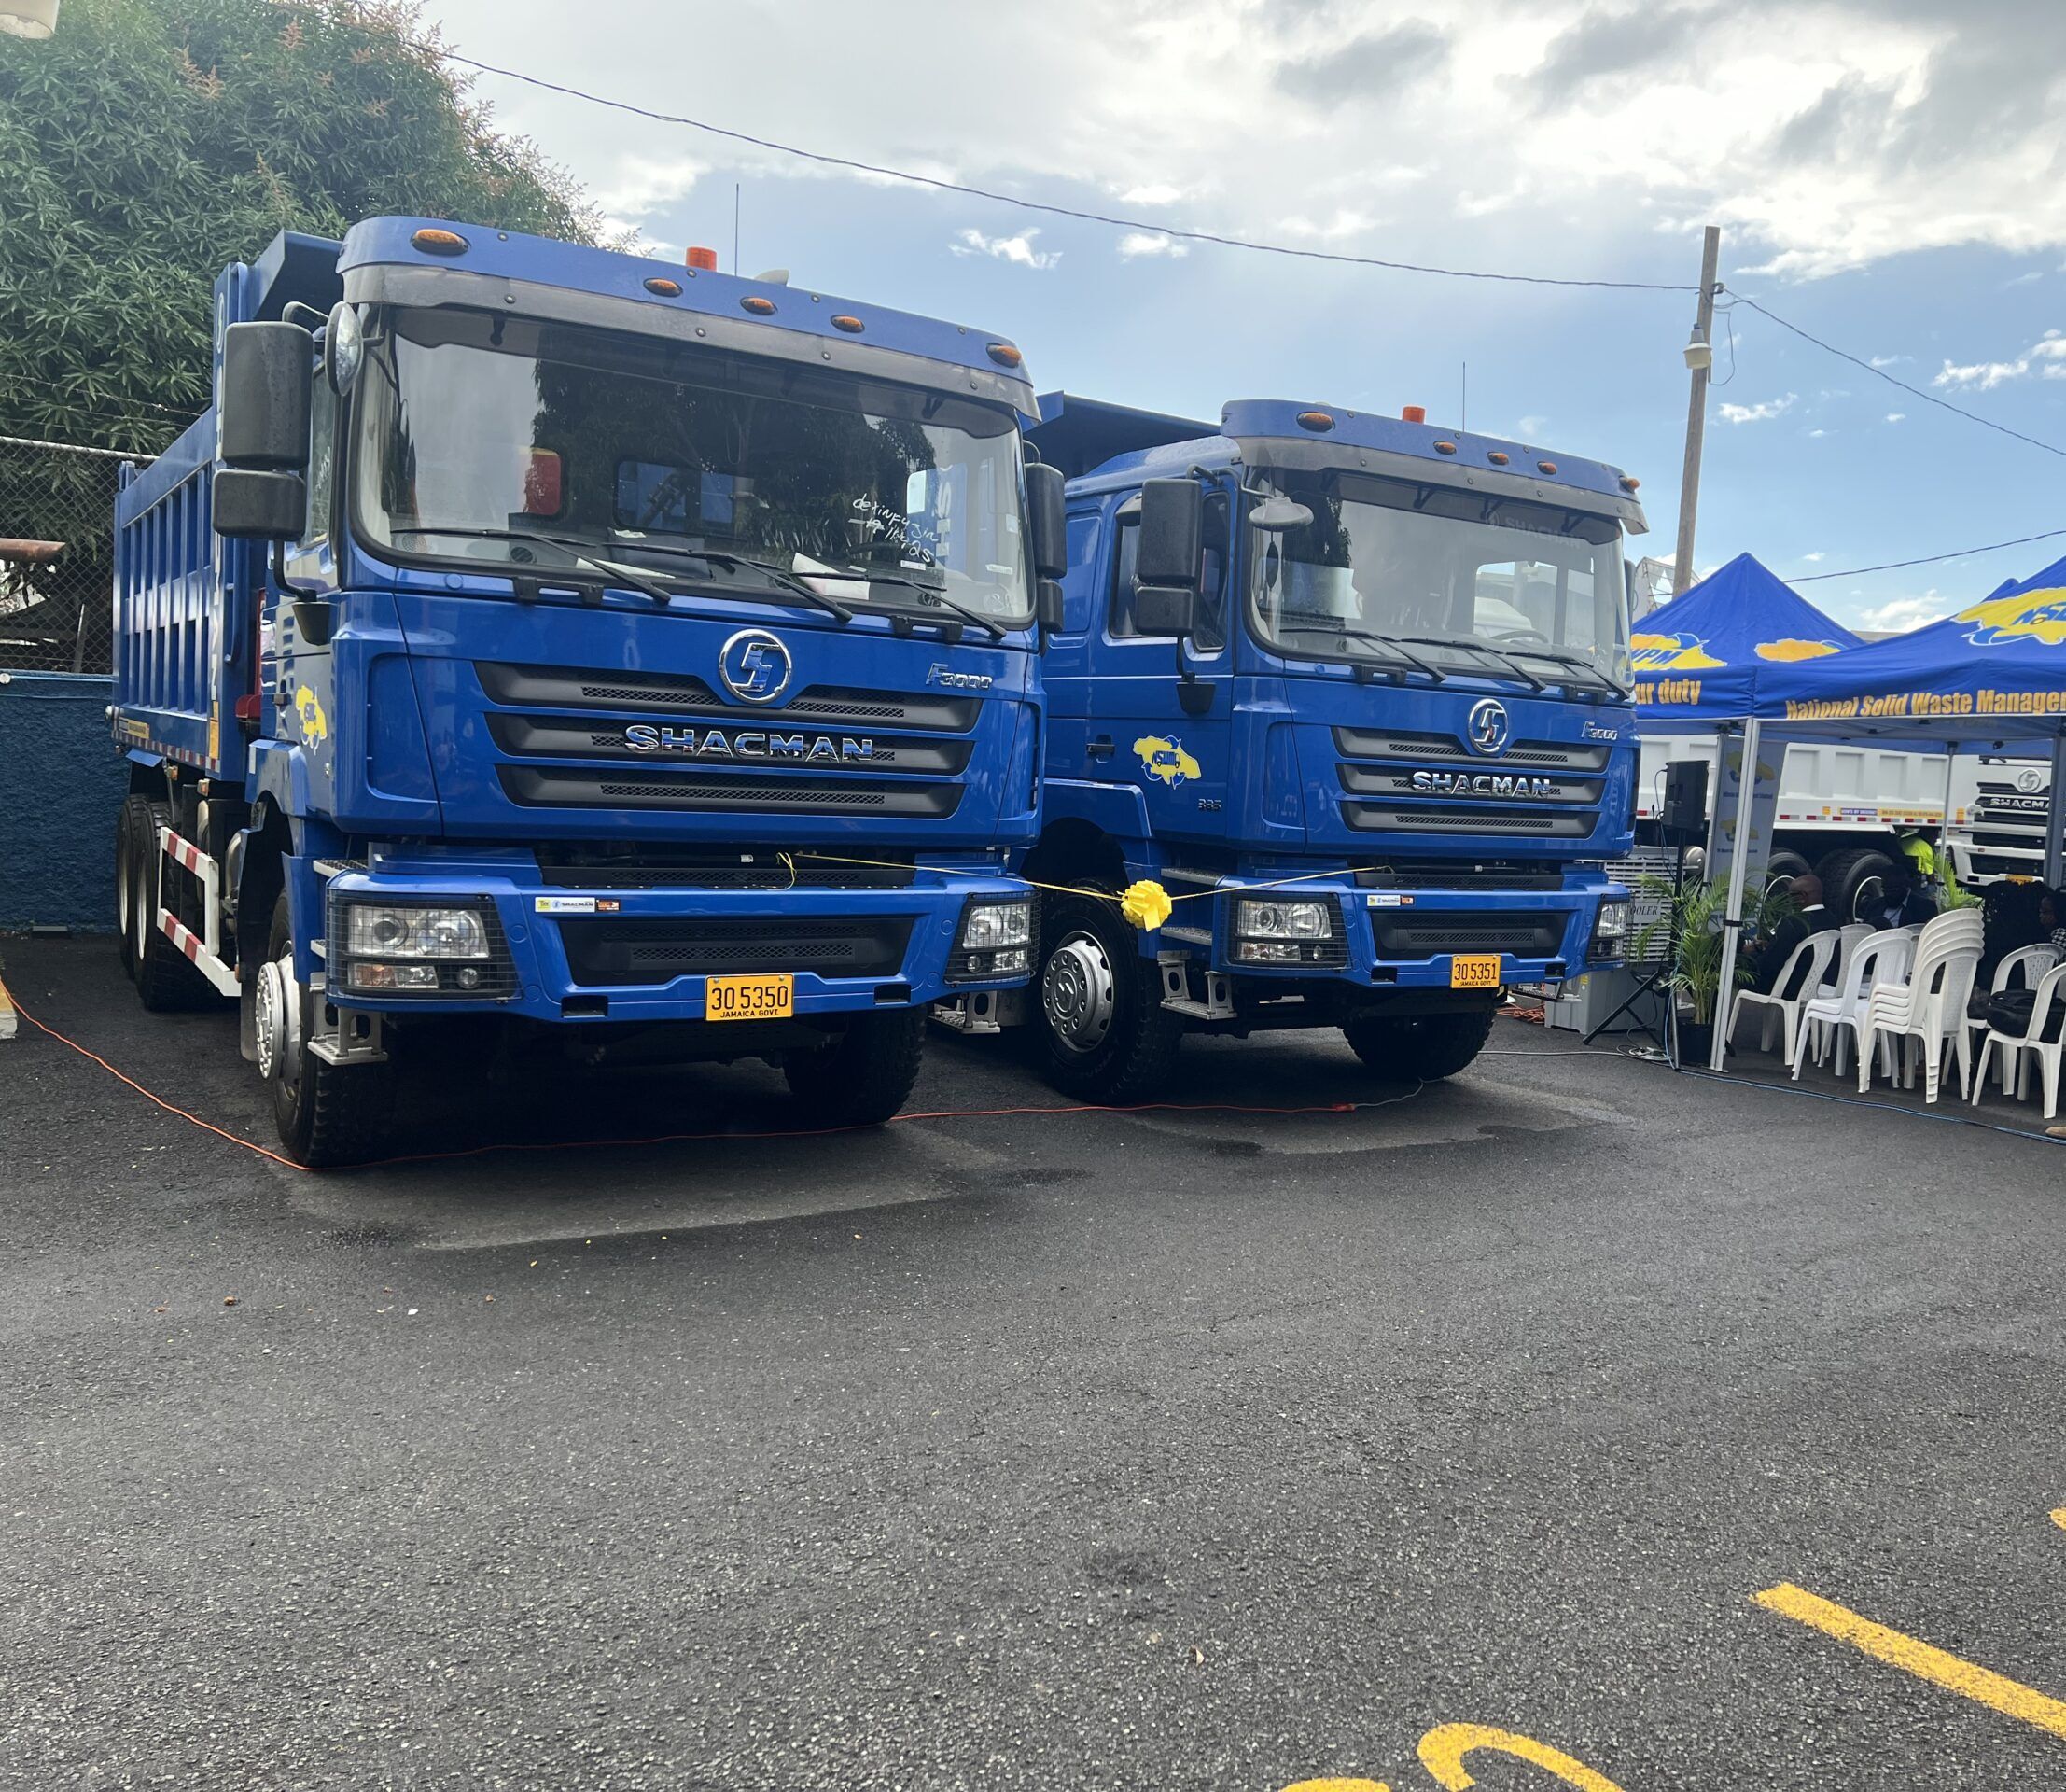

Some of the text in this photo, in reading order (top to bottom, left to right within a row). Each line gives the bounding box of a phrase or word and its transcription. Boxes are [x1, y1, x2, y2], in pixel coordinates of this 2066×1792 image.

[926, 663, 992, 689] F3000
[1657, 678, 1702, 706] duty
[1785, 690, 2066, 720] National Solid Waste Manage
[624, 724, 872, 763] SHACMAN
[1412, 771, 1552, 798] SHACMAN
[1989, 797, 2049, 809] SHACM
[1455, 962, 1497, 980] 30 5351
[711, 986, 789, 1010] 30 5350
